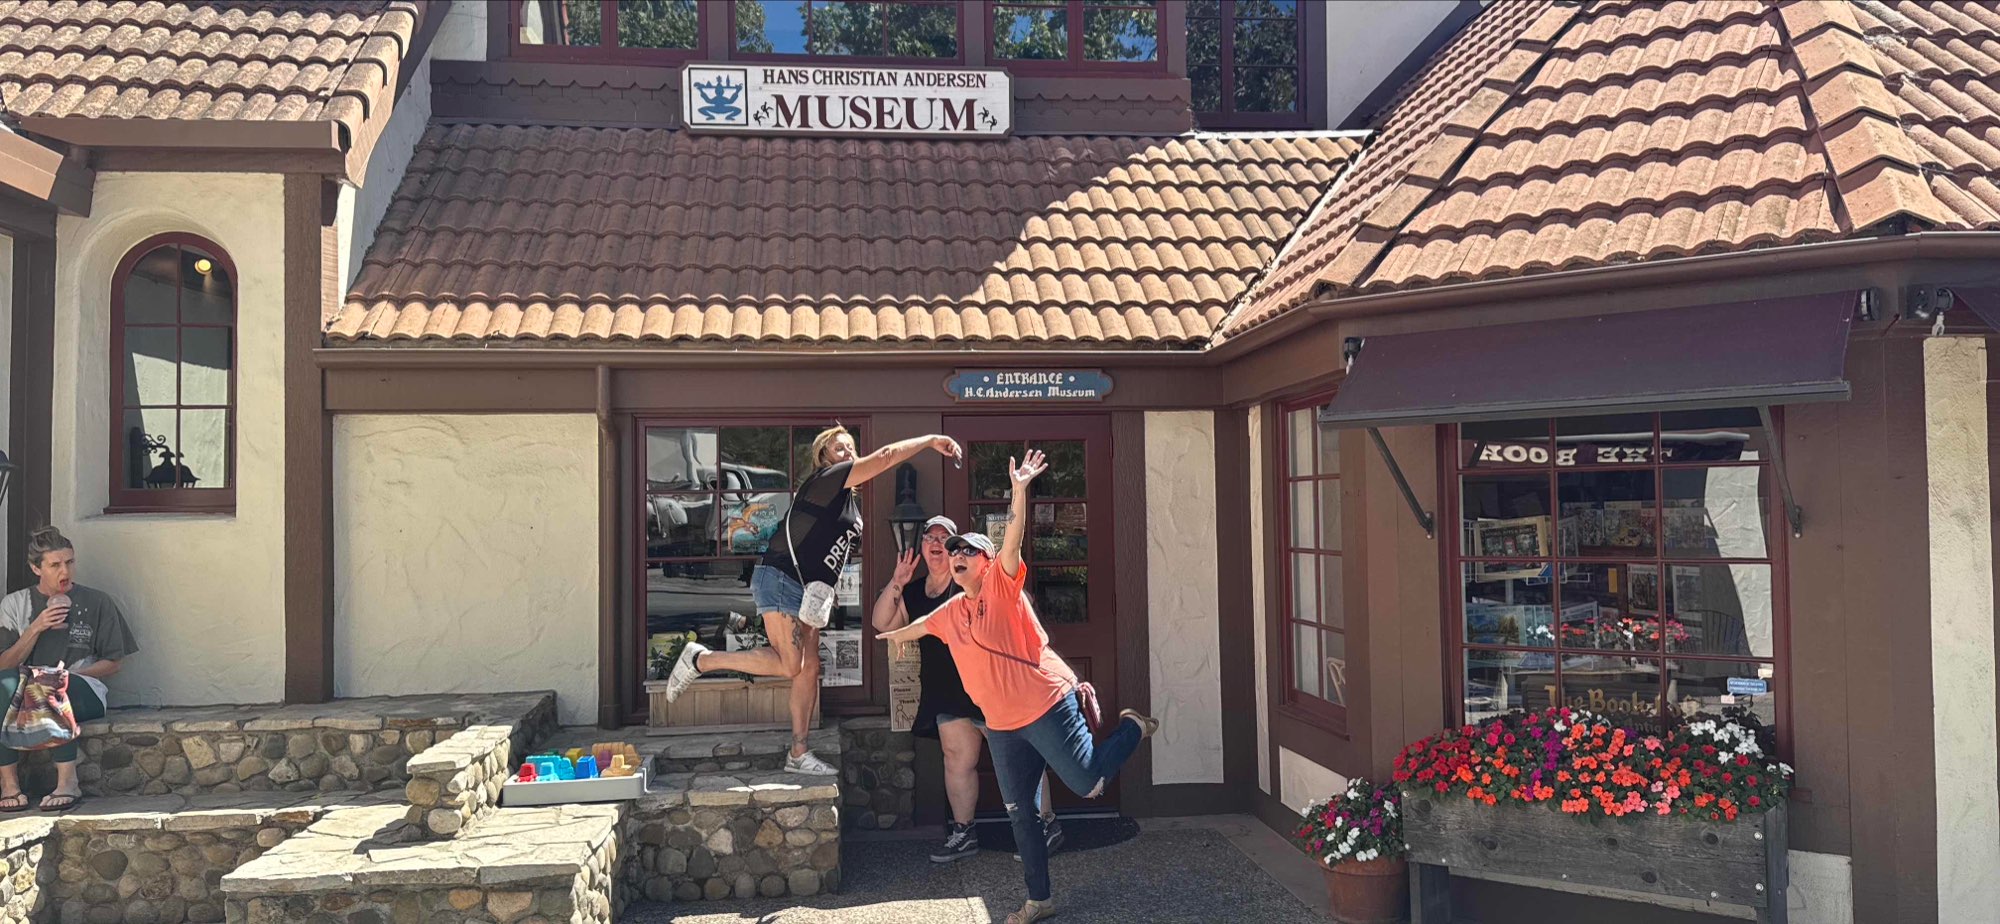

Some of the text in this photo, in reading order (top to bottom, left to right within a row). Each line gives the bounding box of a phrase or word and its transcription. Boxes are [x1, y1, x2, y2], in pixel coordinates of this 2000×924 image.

[763, 68, 988, 89] HANS CHRISTIAN ANDERSEN
[772, 94, 979, 132] MUSEUM
[996, 372, 1064, 385] ENTRANCE
[1047, 386, 1096, 398] Museum
[1588, 688, 1645, 715] Book
